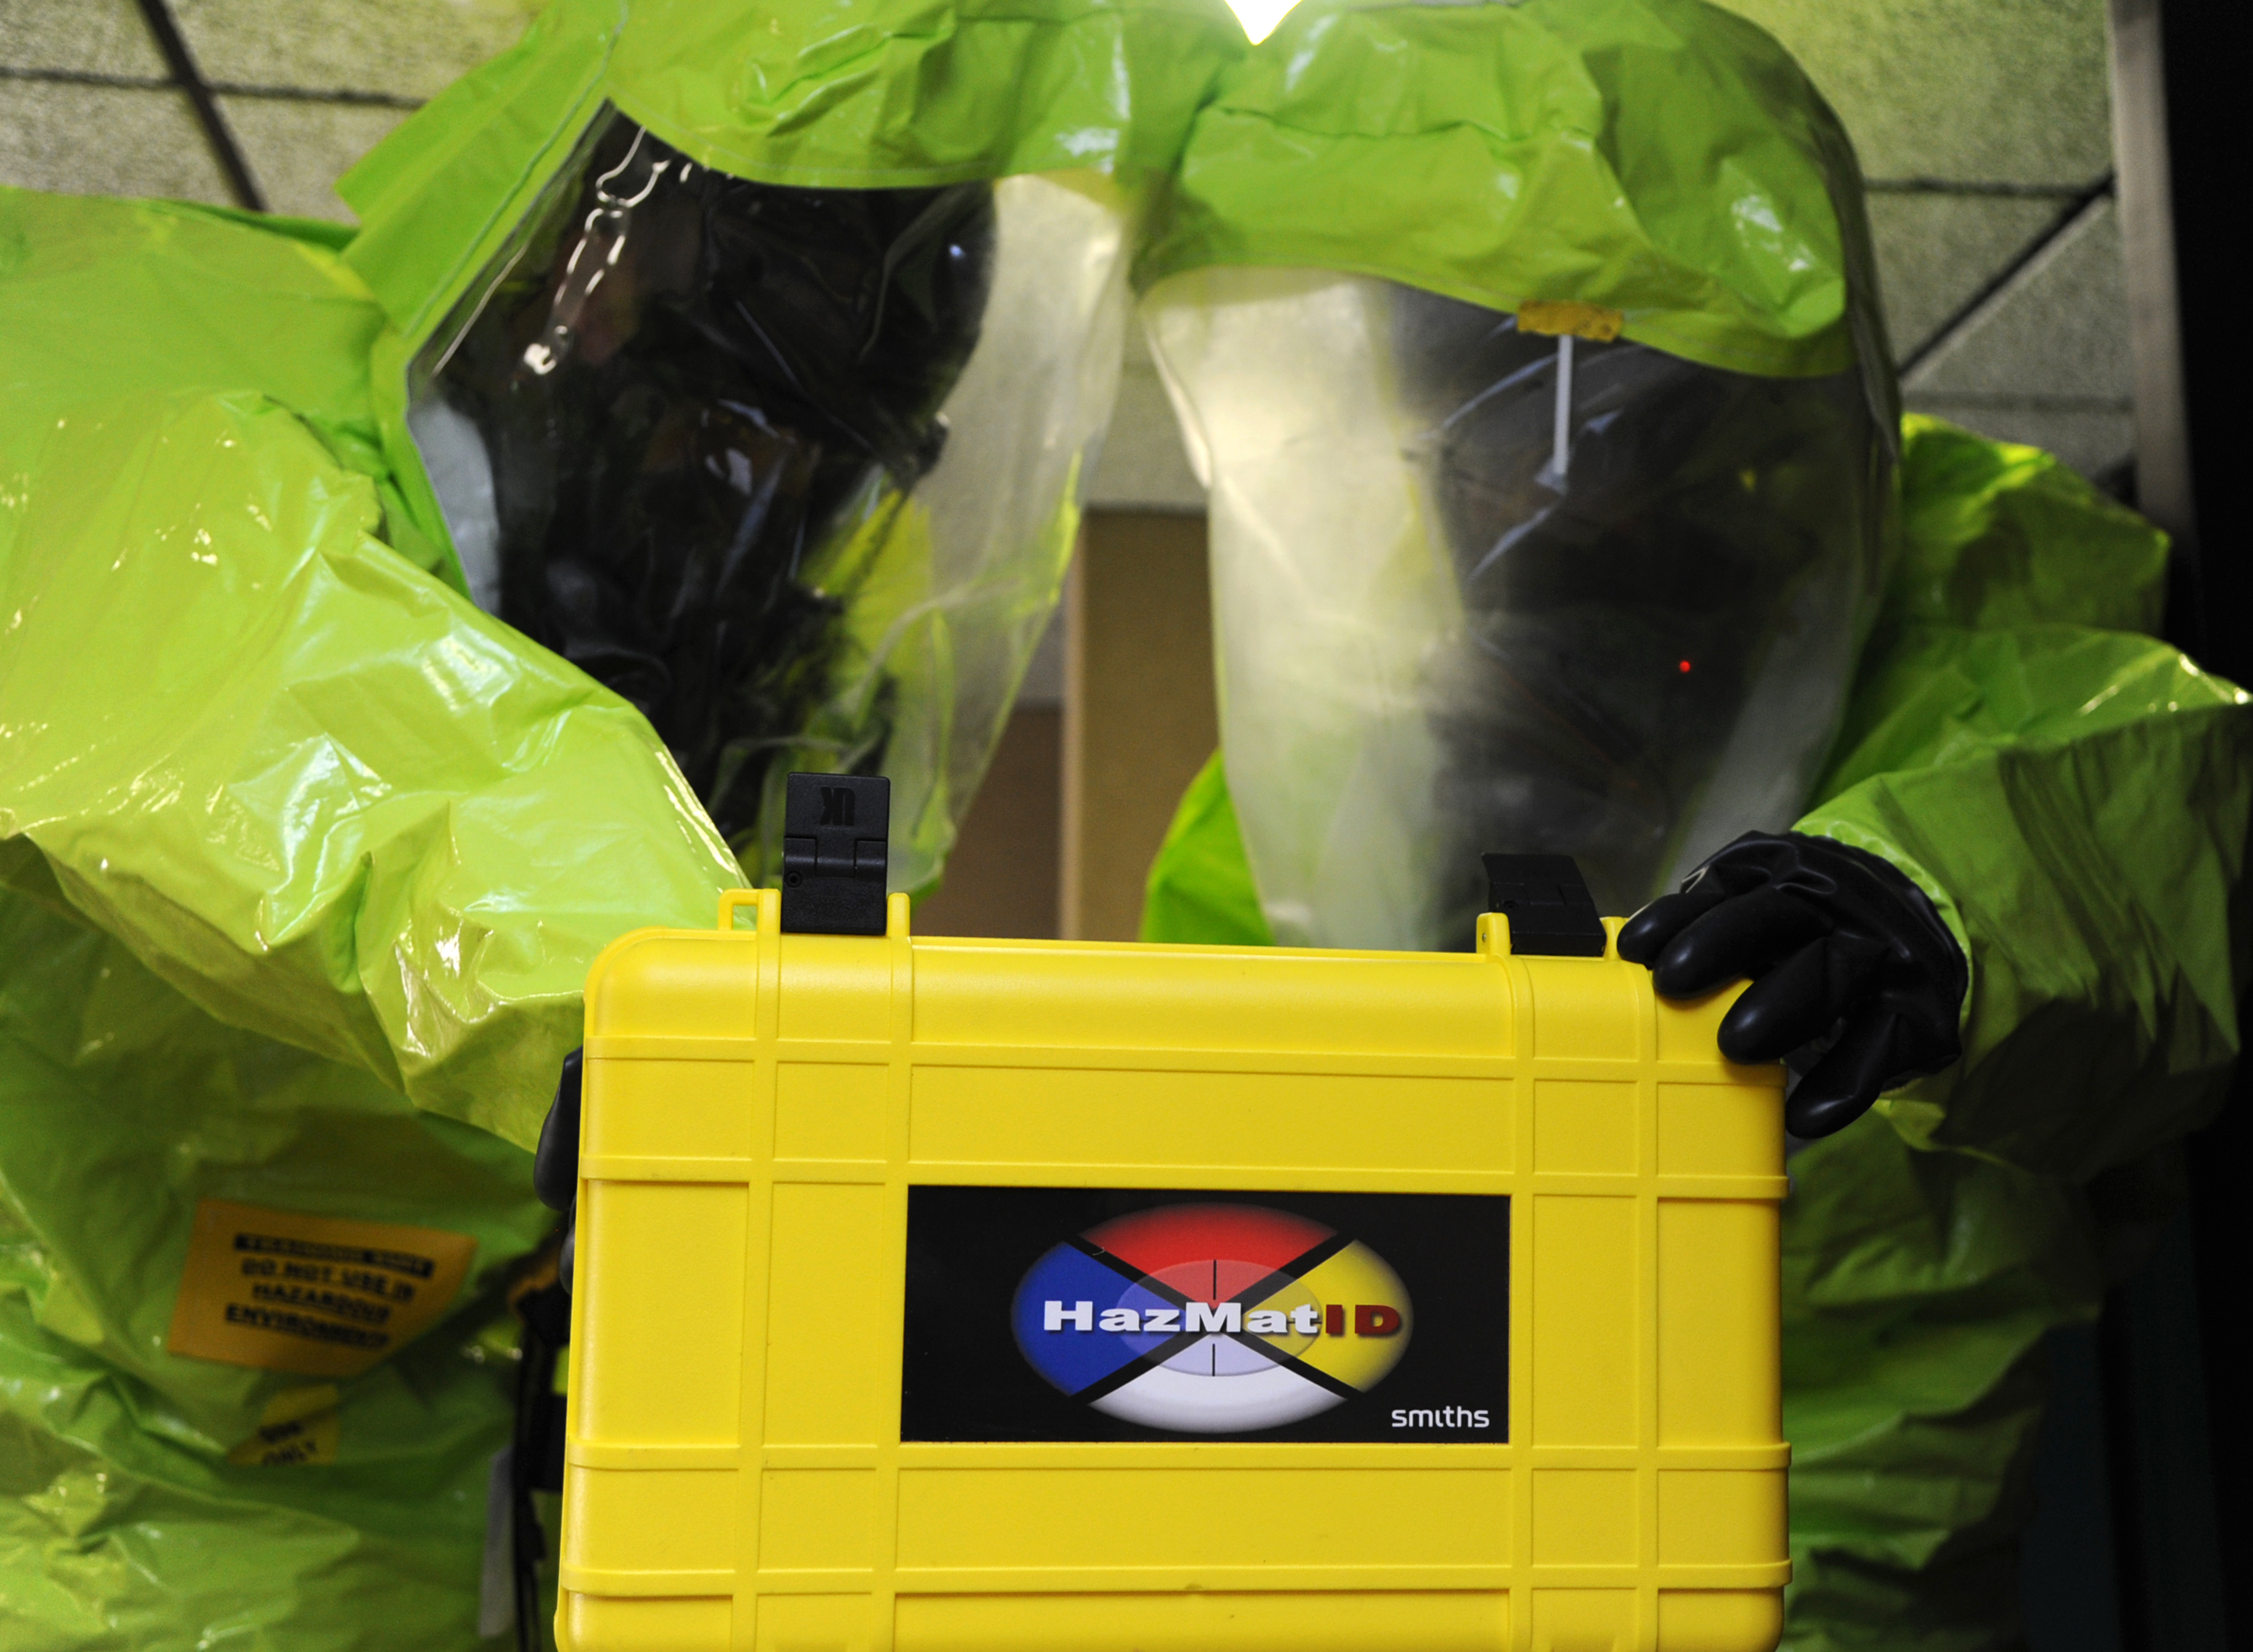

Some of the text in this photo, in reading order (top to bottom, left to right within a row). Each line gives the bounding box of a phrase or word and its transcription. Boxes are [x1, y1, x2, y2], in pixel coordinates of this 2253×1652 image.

[242, 1259, 276, 1277] DO
[285, 1262, 332, 1283] NOT
[342, 1269, 386, 1294] USE
[1044, 1300, 1400, 1335] HazMatID
[1391, 1405, 1490, 1427] smiths
